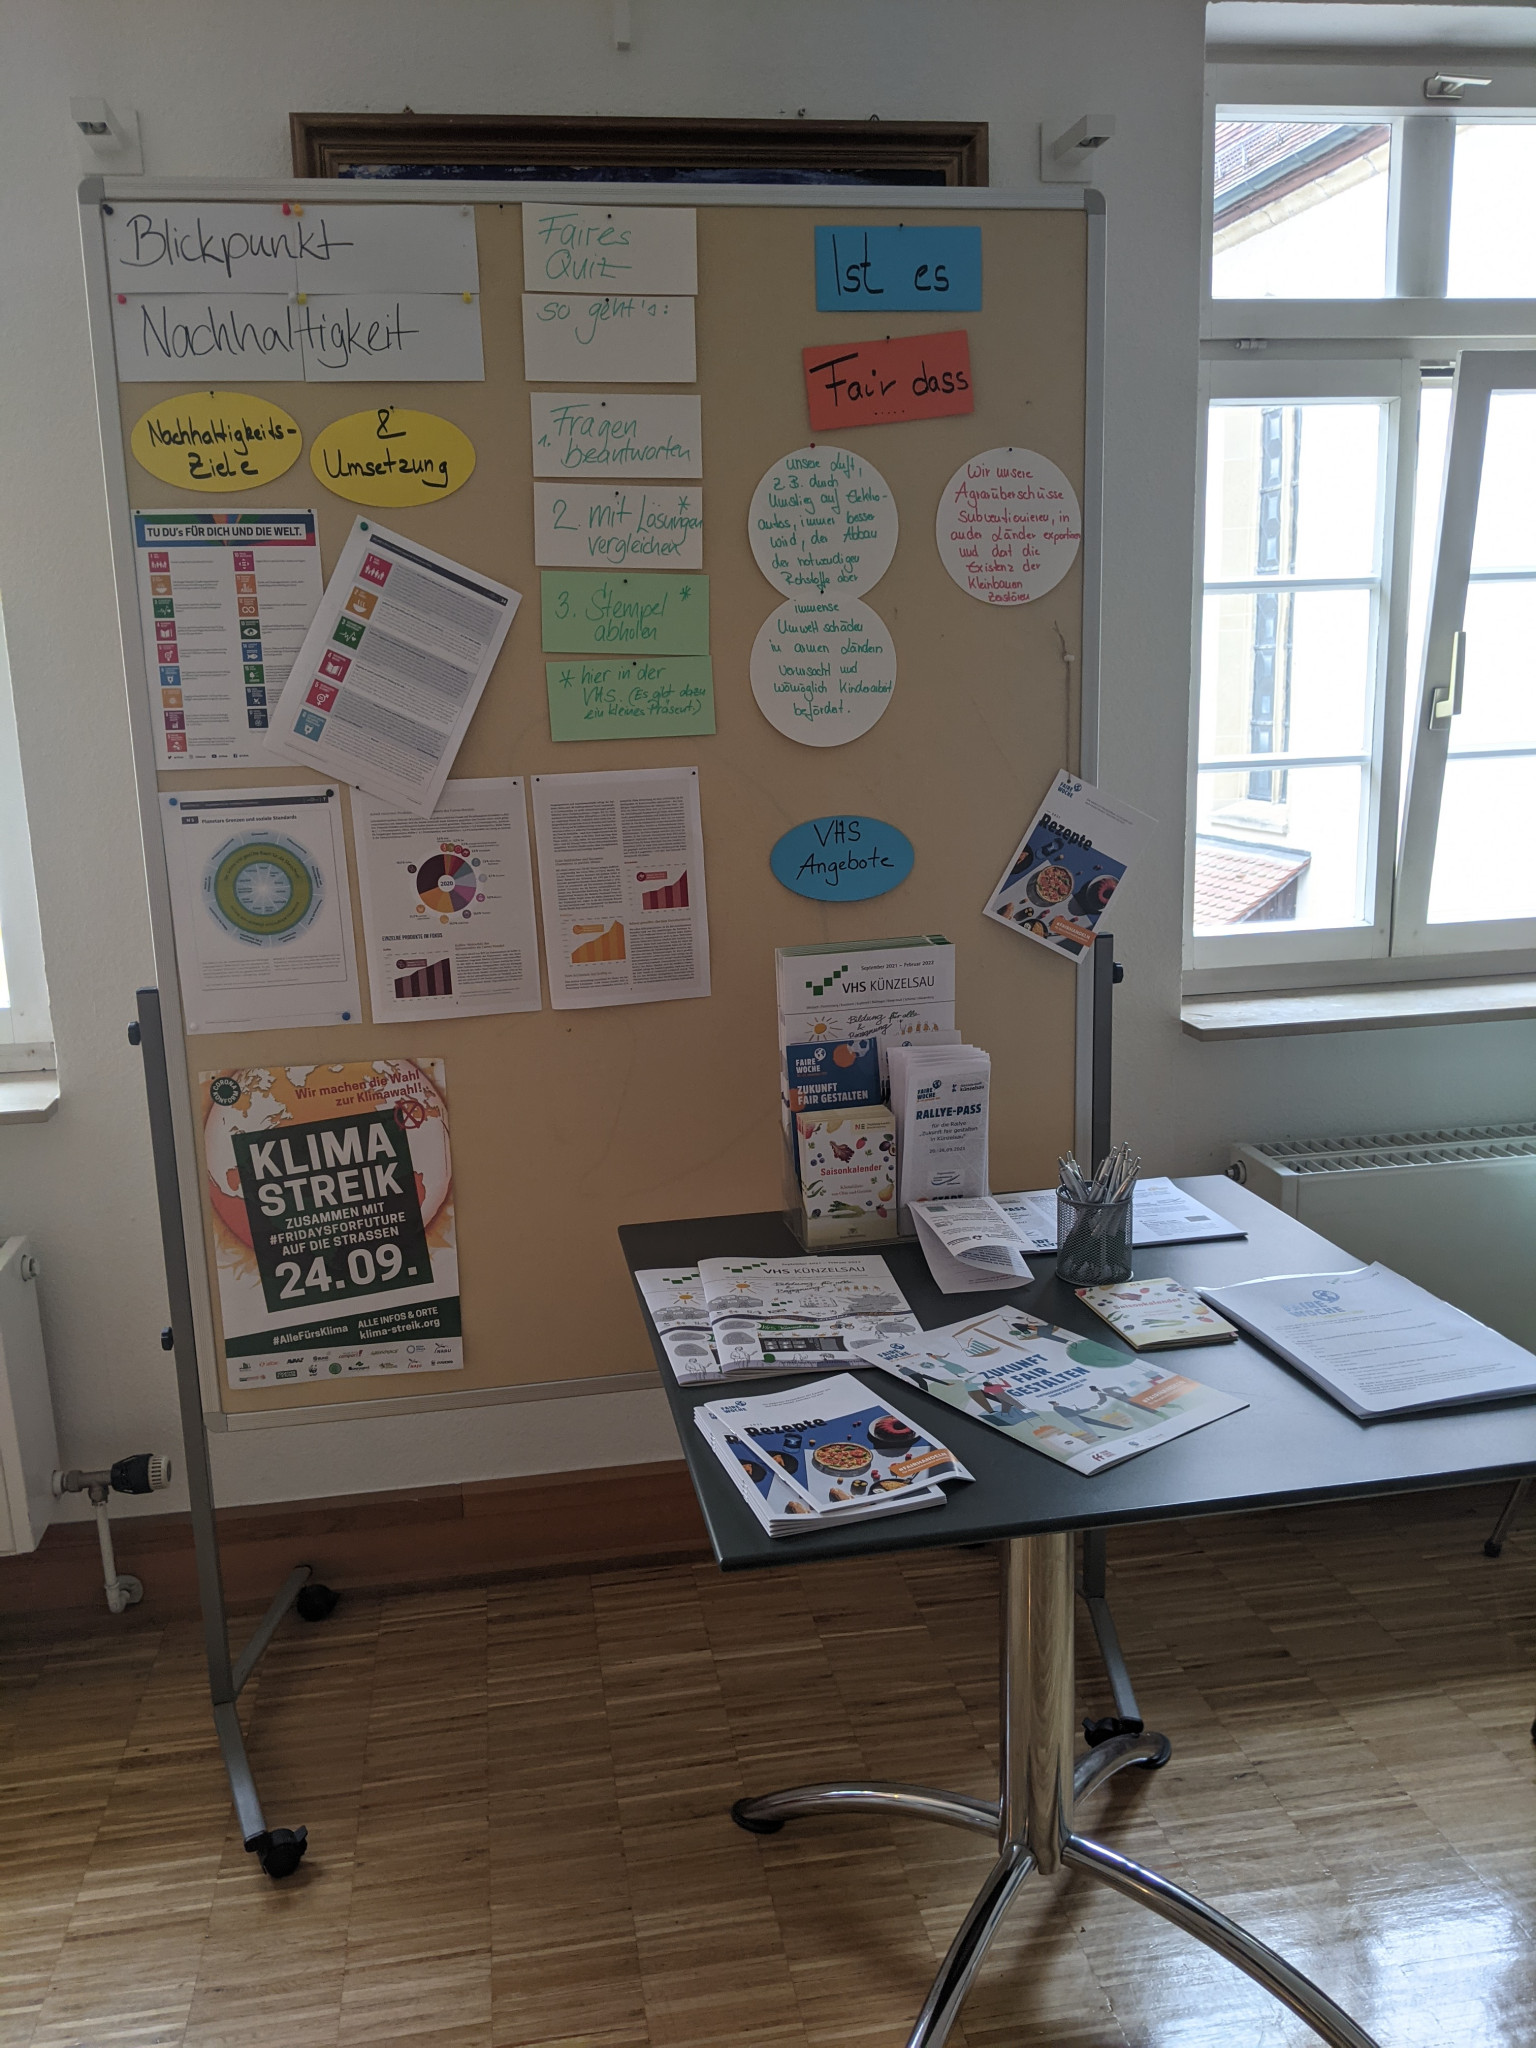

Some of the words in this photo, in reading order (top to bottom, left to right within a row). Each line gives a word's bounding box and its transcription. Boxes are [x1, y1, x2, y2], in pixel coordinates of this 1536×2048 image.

[538, 213, 631, 249] Faires
[120, 214, 353, 277] Blickpunkt
[546, 249, 633, 280] Quiz
[832, 232, 884, 296] Ist
[914, 264, 950, 292] es
[536, 302, 571, 321] so
[575, 297, 668, 345] geht's:
[141, 302, 419, 368] Nachhaltigkeit
[809, 352, 896, 407] Fair
[912, 360, 969, 396] dass
[376, 409, 406, 439] &
[550, 404, 637, 446] Fragen
[537, 434, 551, 448] 1.
[561, 435, 691, 468] beantworten
[188, 452, 258, 480] Ziele
[323, 447, 448, 488] Umsetzung
[786, 458, 821, 471] unsere
[967, 463, 990, 479] Wir
[997, 467, 1033, 479] unsere
[809, 474, 838, 488] durch
[768, 493, 815, 515] Umstieg
[820, 488, 841, 515] auf
[955, 481, 1064, 508] Agrarüberschüsse
[589, 495, 632, 528] mit
[800, 515, 835, 528] immer
[1059, 511, 1070, 523] in
[147, 527, 160, 537] TU
[162, 526, 183, 537] DU's
[185, 525, 205, 536] FÜR
[207, 526, 229, 536] DICH
[232, 526, 253, 536] UND
[256, 526, 272, 536] DIE
[274, 526, 302, 536] WELT.
[811, 530, 828, 545] der
[843, 526, 877, 543] Abbau
[991, 526, 1036, 542] Länder
[588, 533, 681, 564] vergleichen
[959, 545, 978, 558] und
[992, 543, 1012, 558] dort
[1022, 543, 1041, 557] die
[772, 553, 789, 569] der
[798, 552, 860, 573] notwendigen
[966, 559, 1014, 573] Existenz
[1022, 559, 1041, 572] der
[781, 571, 830, 590] Rohstoffe
[838, 570, 858, 583] aber
[555, 591, 576, 620] 3.
[585, 582, 668, 624] Stempel
[794, 600, 839, 613] immense
[594, 620, 657, 642] abholen
[769, 639, 781, 653] in
[794, 643, 830, 653] armen
[841, 638, 883, 654] Ländern
[581, 665, 611, 684] hier
[618, 666, 631, 681] in
[637, 664, 667, 681] der
[779, 662, 831, 676] verursacht
[840, 661, 858, 674] und
[649, 684, 674, 704] gibt
[680, 684, 706, 699] dazu
[839, 679, 892, 693] Kinderarbeit
[584, 705, 604, 720] ein
[609, 703, 645, 717] kleines
[814, 819, 861, 847] VHS
[1038, 812, 1093, 851] Rezepte
[796, 846, 894, 886] Angebote
[842, 981, 866, 993] VHS
[870, 975, 935, 991] KÜNZELSAU
[847, 1012, 886, 1026] Bildung
[888, 1011, 902, 1022] für
[795, 1058, 816, 1067] FAIRE
[796, 1065, 821, 1073] WOCHE
[212, 1079, 239, 1092] CORONA
[295, 1089, 316, 1100] Wir
[320, 1081, 367, 1095] machen
[369, 1076, 388, 1088] die
[389, 1070, 421, 1086] Wahl
[335, 1096, 355, 1107] zur
[356, 1083, 422, 1103] Klimawahl!
[797, 1082, 837, 1094] ZUKUNFT
[212, 1089, 240, 1106] KONFORM
[798, 1095, 818, 1105] FAIR
[821, 1090, 869, 1104] GESTALTEN
[917, 1092, 936, 1100] WOCHE
[916, 1103, 982, 1120] RALLYE-PASS
[249, 1122, 397, 1180] KLIMA
[820, 1164, 882, 1176] Saisonkalender
[258, 1162, 404, 1217] STREIK
[285, 1208, 360, 1229] ZUSAMMEN
[362, 1202, 385, 1216] MIT
[269, 1213, 407, 1246] #FRIDAYSFORFUTURE
[282, 1242, 308, 1256] AUF
[309, 1238, 331, 1251] DIE
[333, 1226, 400, 1248] STRASSEN
[275, 1243, 418, 1300] 24.09.
[763, 1268, 790, 1276] VHS
[794, 1265, 866, 1274] KÜNZELSAU
[1113, 1297, 1181, 1310] Saisonkalender
[358, 1318, 379, 1328] ALLE
[380, 1312, 407, 1325] INFOS
[407, 1310, 414, 1319] &
[415, 1307, 438, 1318] ORTE
[272, 1324, 349, 1346] #AlleFürsKlima
[359, 1317, 441, 1340] klima-streik.org
[979, 1353, 1049, 1380] ZUKUNFT
[1013, 1368, 1053, 1385] FAIR
[1007, 1366, 1091, 1398] GESTALTEN
[744, 1417, 828, 1438] Rezepte
[898, 1452, 948, 1473] #FAIRHANDELN
